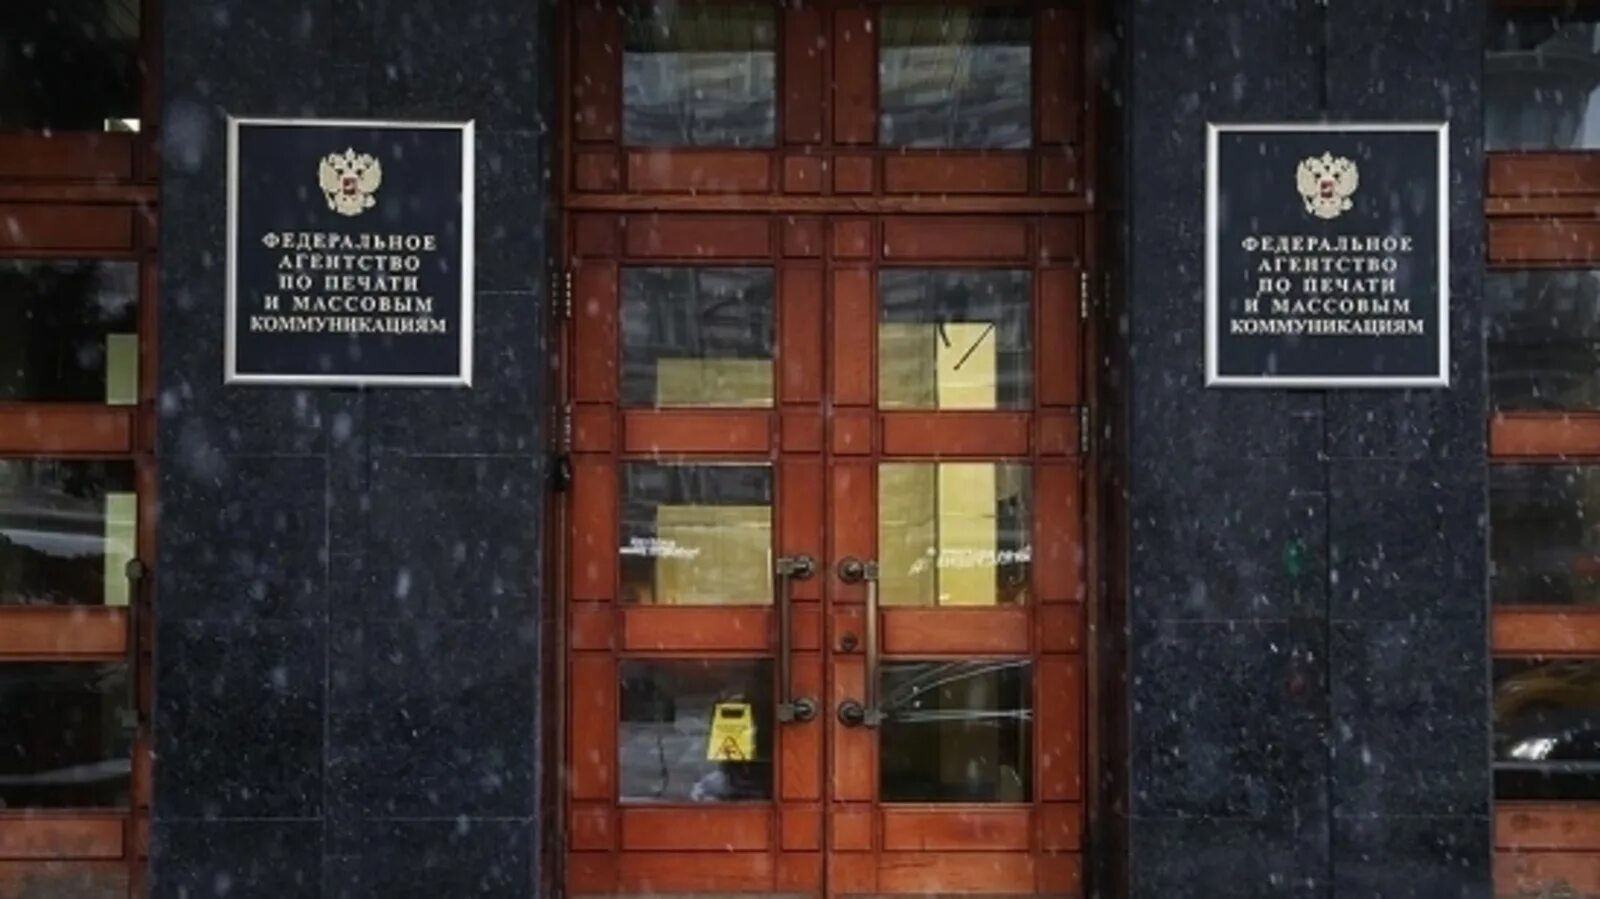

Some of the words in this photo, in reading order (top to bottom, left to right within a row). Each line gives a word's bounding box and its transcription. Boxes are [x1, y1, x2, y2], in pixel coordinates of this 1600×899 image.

[261, 232, 437, 251] ФЕДЕРАЛЬНОЕ
[1241, 235, 1413, 254] ФЕДЕРАЛЬНОЕ
[278, 254, 421, 271] АГЕНТСТВО
[1258, 256, 1399, 274] АГЕНТСТВО
[278, 275, 313, 291] ПО
[324, 275, 419, 292] ПЕЧАТИ
[1258, 277, 1292, 294] ПО
[1303, 277, 1397, 294] ПЕЧАТИ
[264, 296, 279, 311] И
[293, 296, 433, 313] МАССОВЫМ
[1244, 298, 1259, 314] И
[1272, 298, 1411, 315] МАССОВЫМ
[250, 316, 447, 335] КОММУНИКАЦИЯМ
[1230, 318, 1425, 337] КОММУНИКАЦИЯМ
